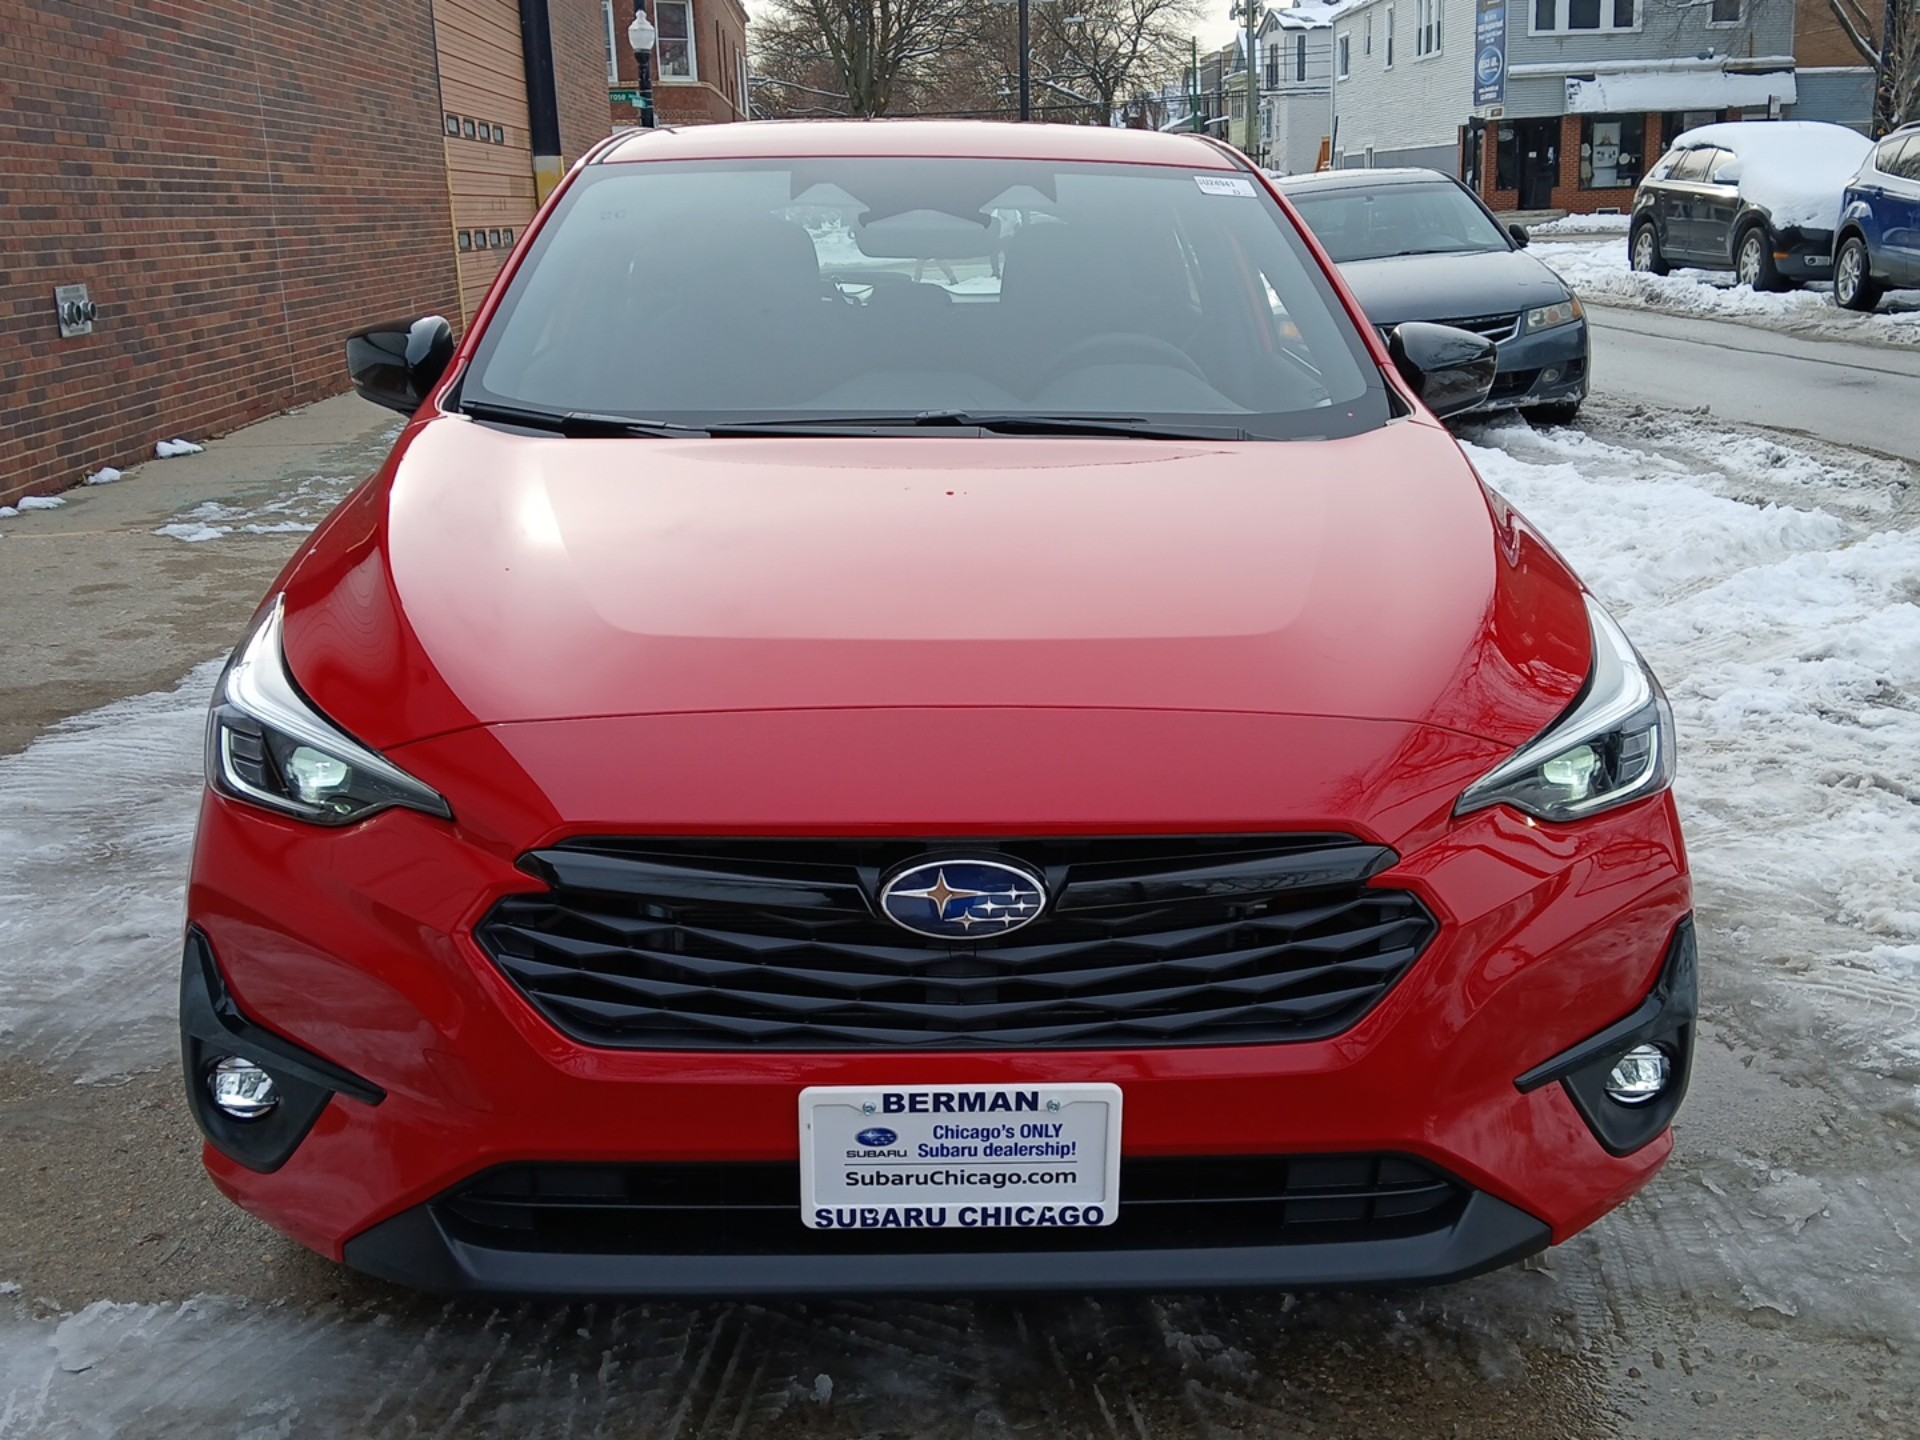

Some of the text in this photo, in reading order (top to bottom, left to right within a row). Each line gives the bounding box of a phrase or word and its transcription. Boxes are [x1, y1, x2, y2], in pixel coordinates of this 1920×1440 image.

[882, 1091, 1039, 1113] BERMAN
[933, 1123, 1063, 1141] Chicago's ONLY
[846, 1150, 907, 1158] SUBARU
[918, 1142, 1077, 1160] Subaru dealership!
[845, 1170, 1077, 1188] SubaruChicago.com
[815, 1206, 1105, 1228] SUBARU CHICAGO
